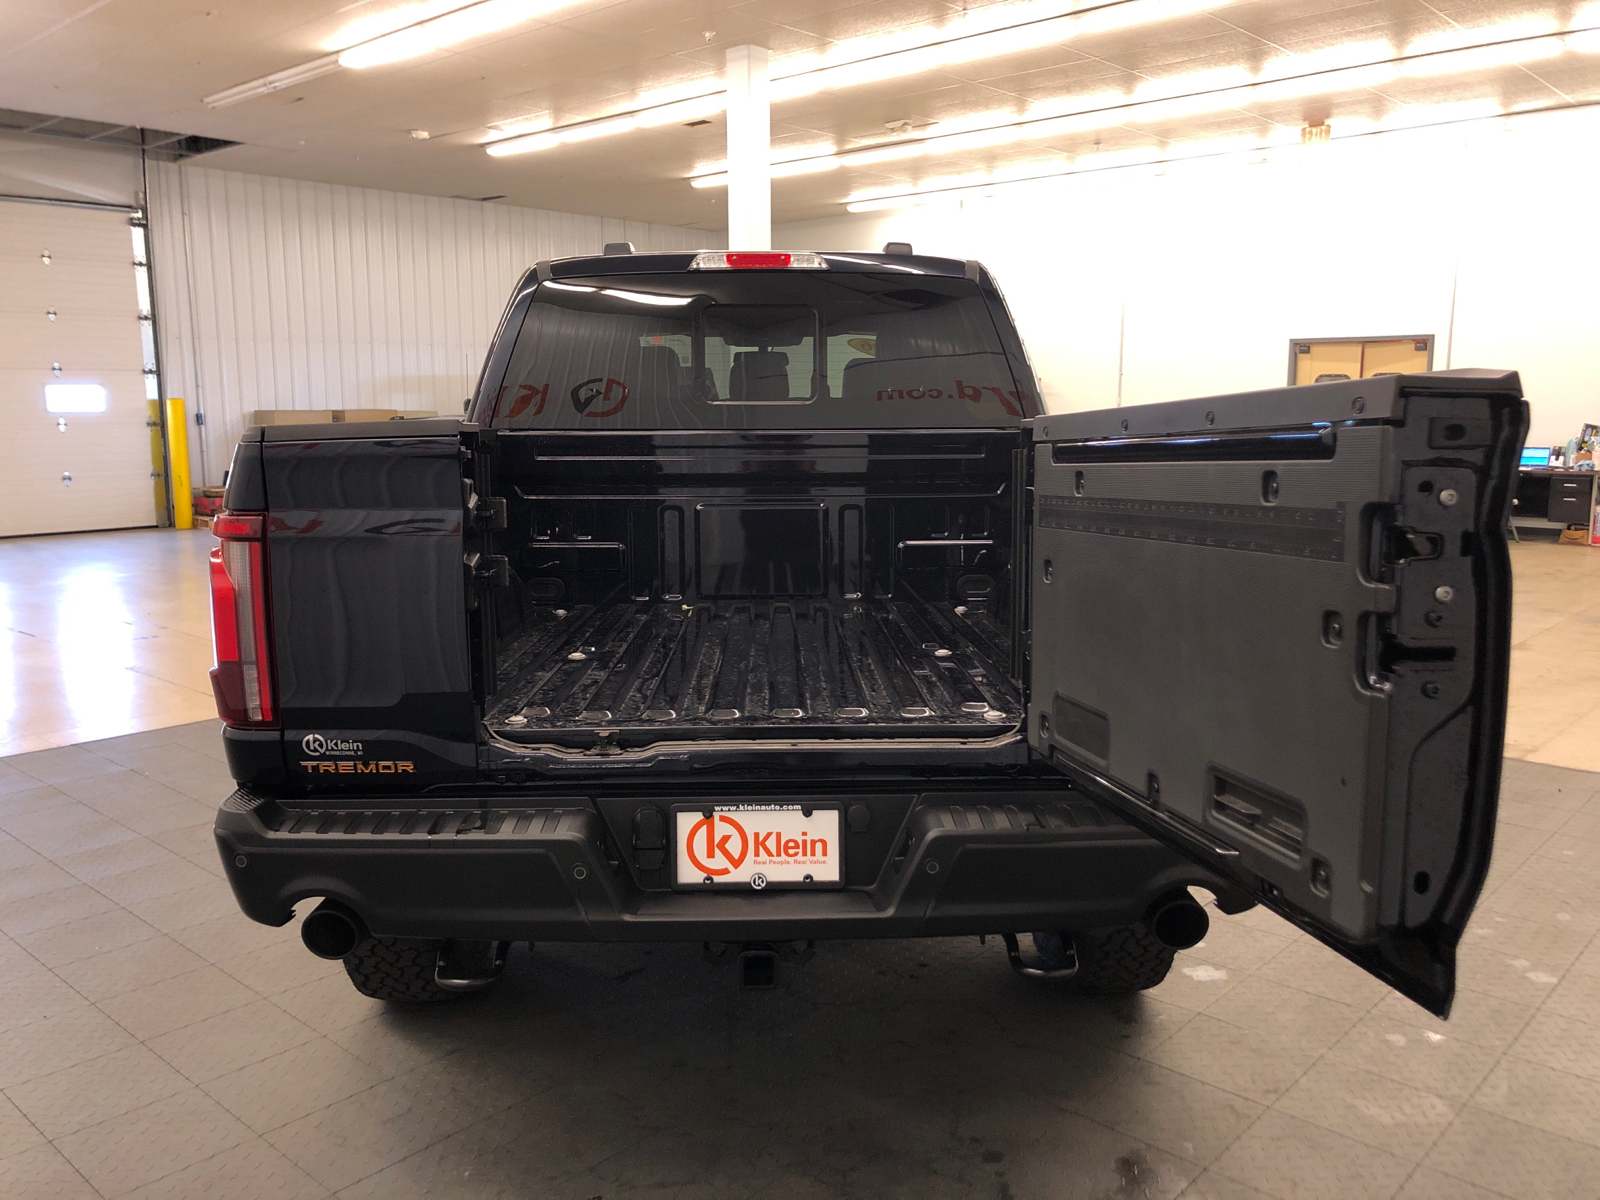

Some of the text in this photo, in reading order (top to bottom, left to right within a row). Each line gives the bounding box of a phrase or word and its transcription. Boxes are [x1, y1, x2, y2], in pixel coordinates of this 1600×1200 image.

[327, 740, 363, 750] Klein
[300, 761, 415, 773] TREMOR
[714, 804, 802, 812] www.kleinauto.com
[753, 831, 828, 858] Klein
[768, 859, 792, 867] People.
